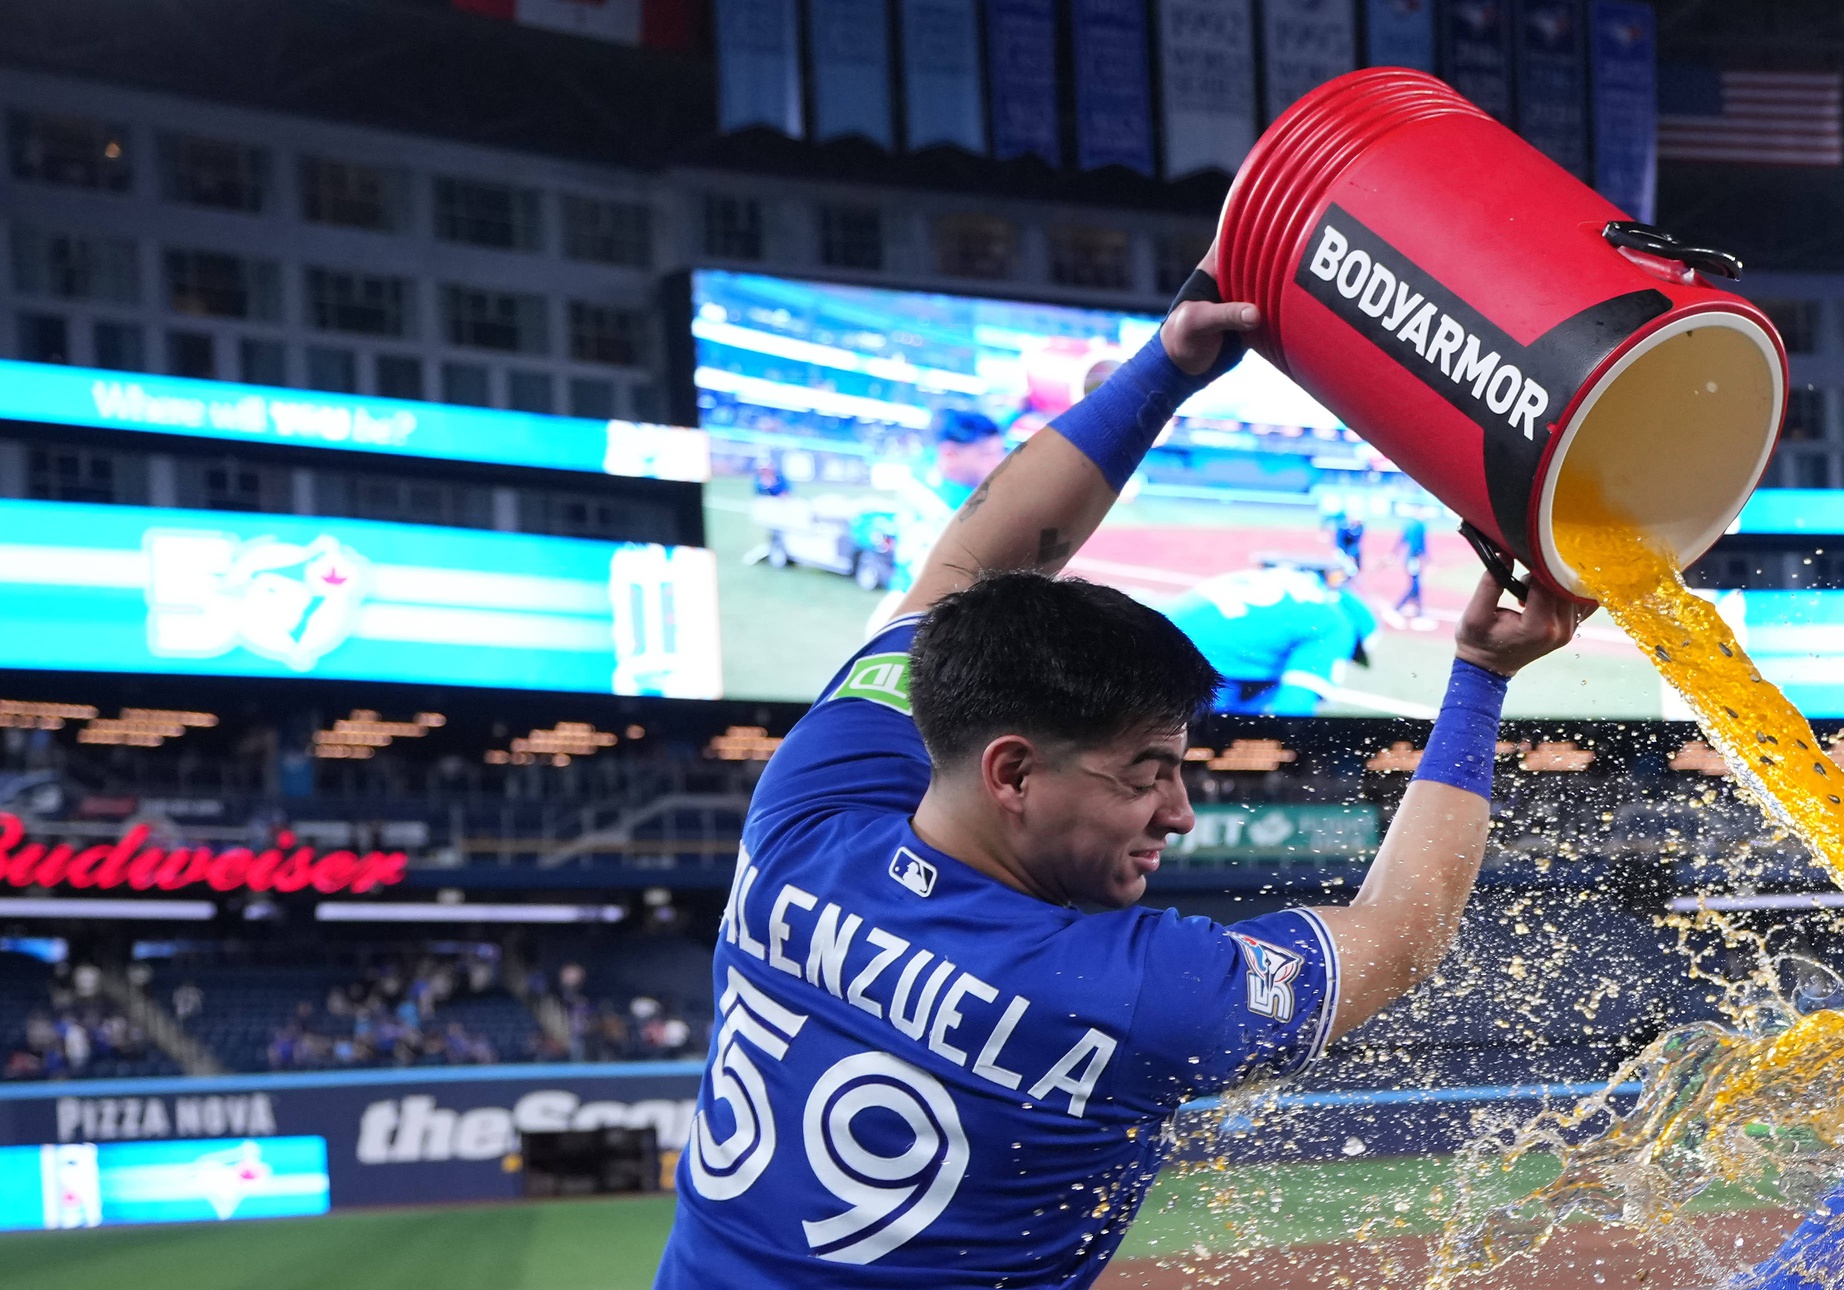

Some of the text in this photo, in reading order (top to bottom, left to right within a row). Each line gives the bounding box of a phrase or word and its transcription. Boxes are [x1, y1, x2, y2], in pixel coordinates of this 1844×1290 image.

[1309, 225, 1549, 441] BODYARMOR
[718, 838, 1117, 1120] ALENZUELA
[57, 1091, 277, 1141] PIZZA NOVA
[690, 965, 971, 1265] 59
